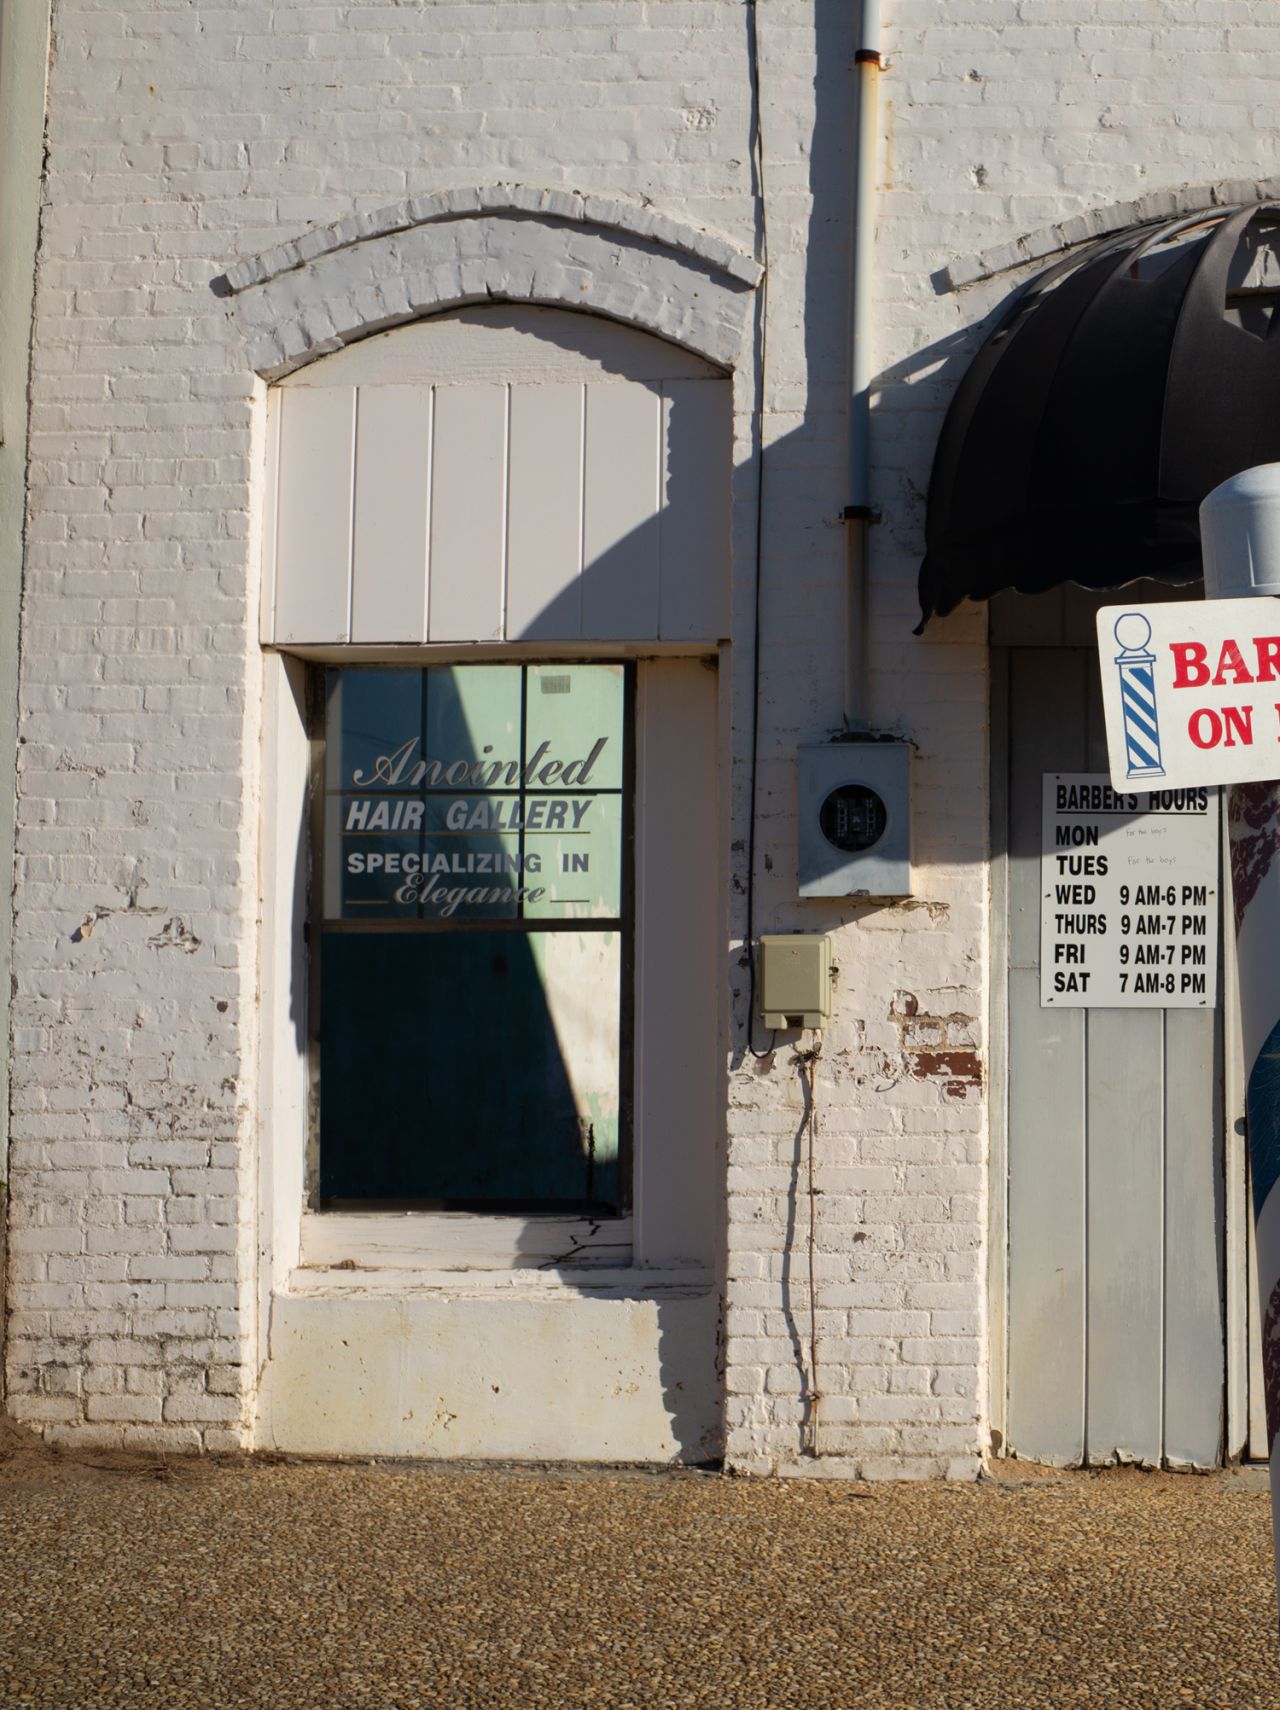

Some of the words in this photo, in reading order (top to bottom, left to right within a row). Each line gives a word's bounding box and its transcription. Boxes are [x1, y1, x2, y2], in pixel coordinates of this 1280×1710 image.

[1187, 704, 1254, 750] ON
[352, 736, 609, 787] Anointed
[1056, 784, 1138, 811] BARBERS
[1149, 785, 1208, 811] HOURS
[345, 800, 426, 831] HAIR
[446, 800, 593, 831] GALLERY
[1055, 825, 1099, 846] MON
[347, 853, 542, 874] SPECIALIZING
[562, 853, 590, 873] IN
[1056, 855, 1109, 876] TUES
[394, 871, 547, 918] Elegance
[1055, 884, 1096, 905] WED
[1120, 885, 1130, 906] 9
[1181, 885, 1207, 906] PM
[1054, 913, 1107, 935] THURS
[1121, 914, 1131, 935] 9
[1181, 915, 1207, 936] PM
[1054, 943, 1086, 964] FRI
[1119, 944, 1129, 965] 9
[1181, 944, 1206, 965] PM
[1054, 972, 1091, 993] SAT
[1119, 973, 1129, 993] 7
[1180, 973, 1206, 994] PM
